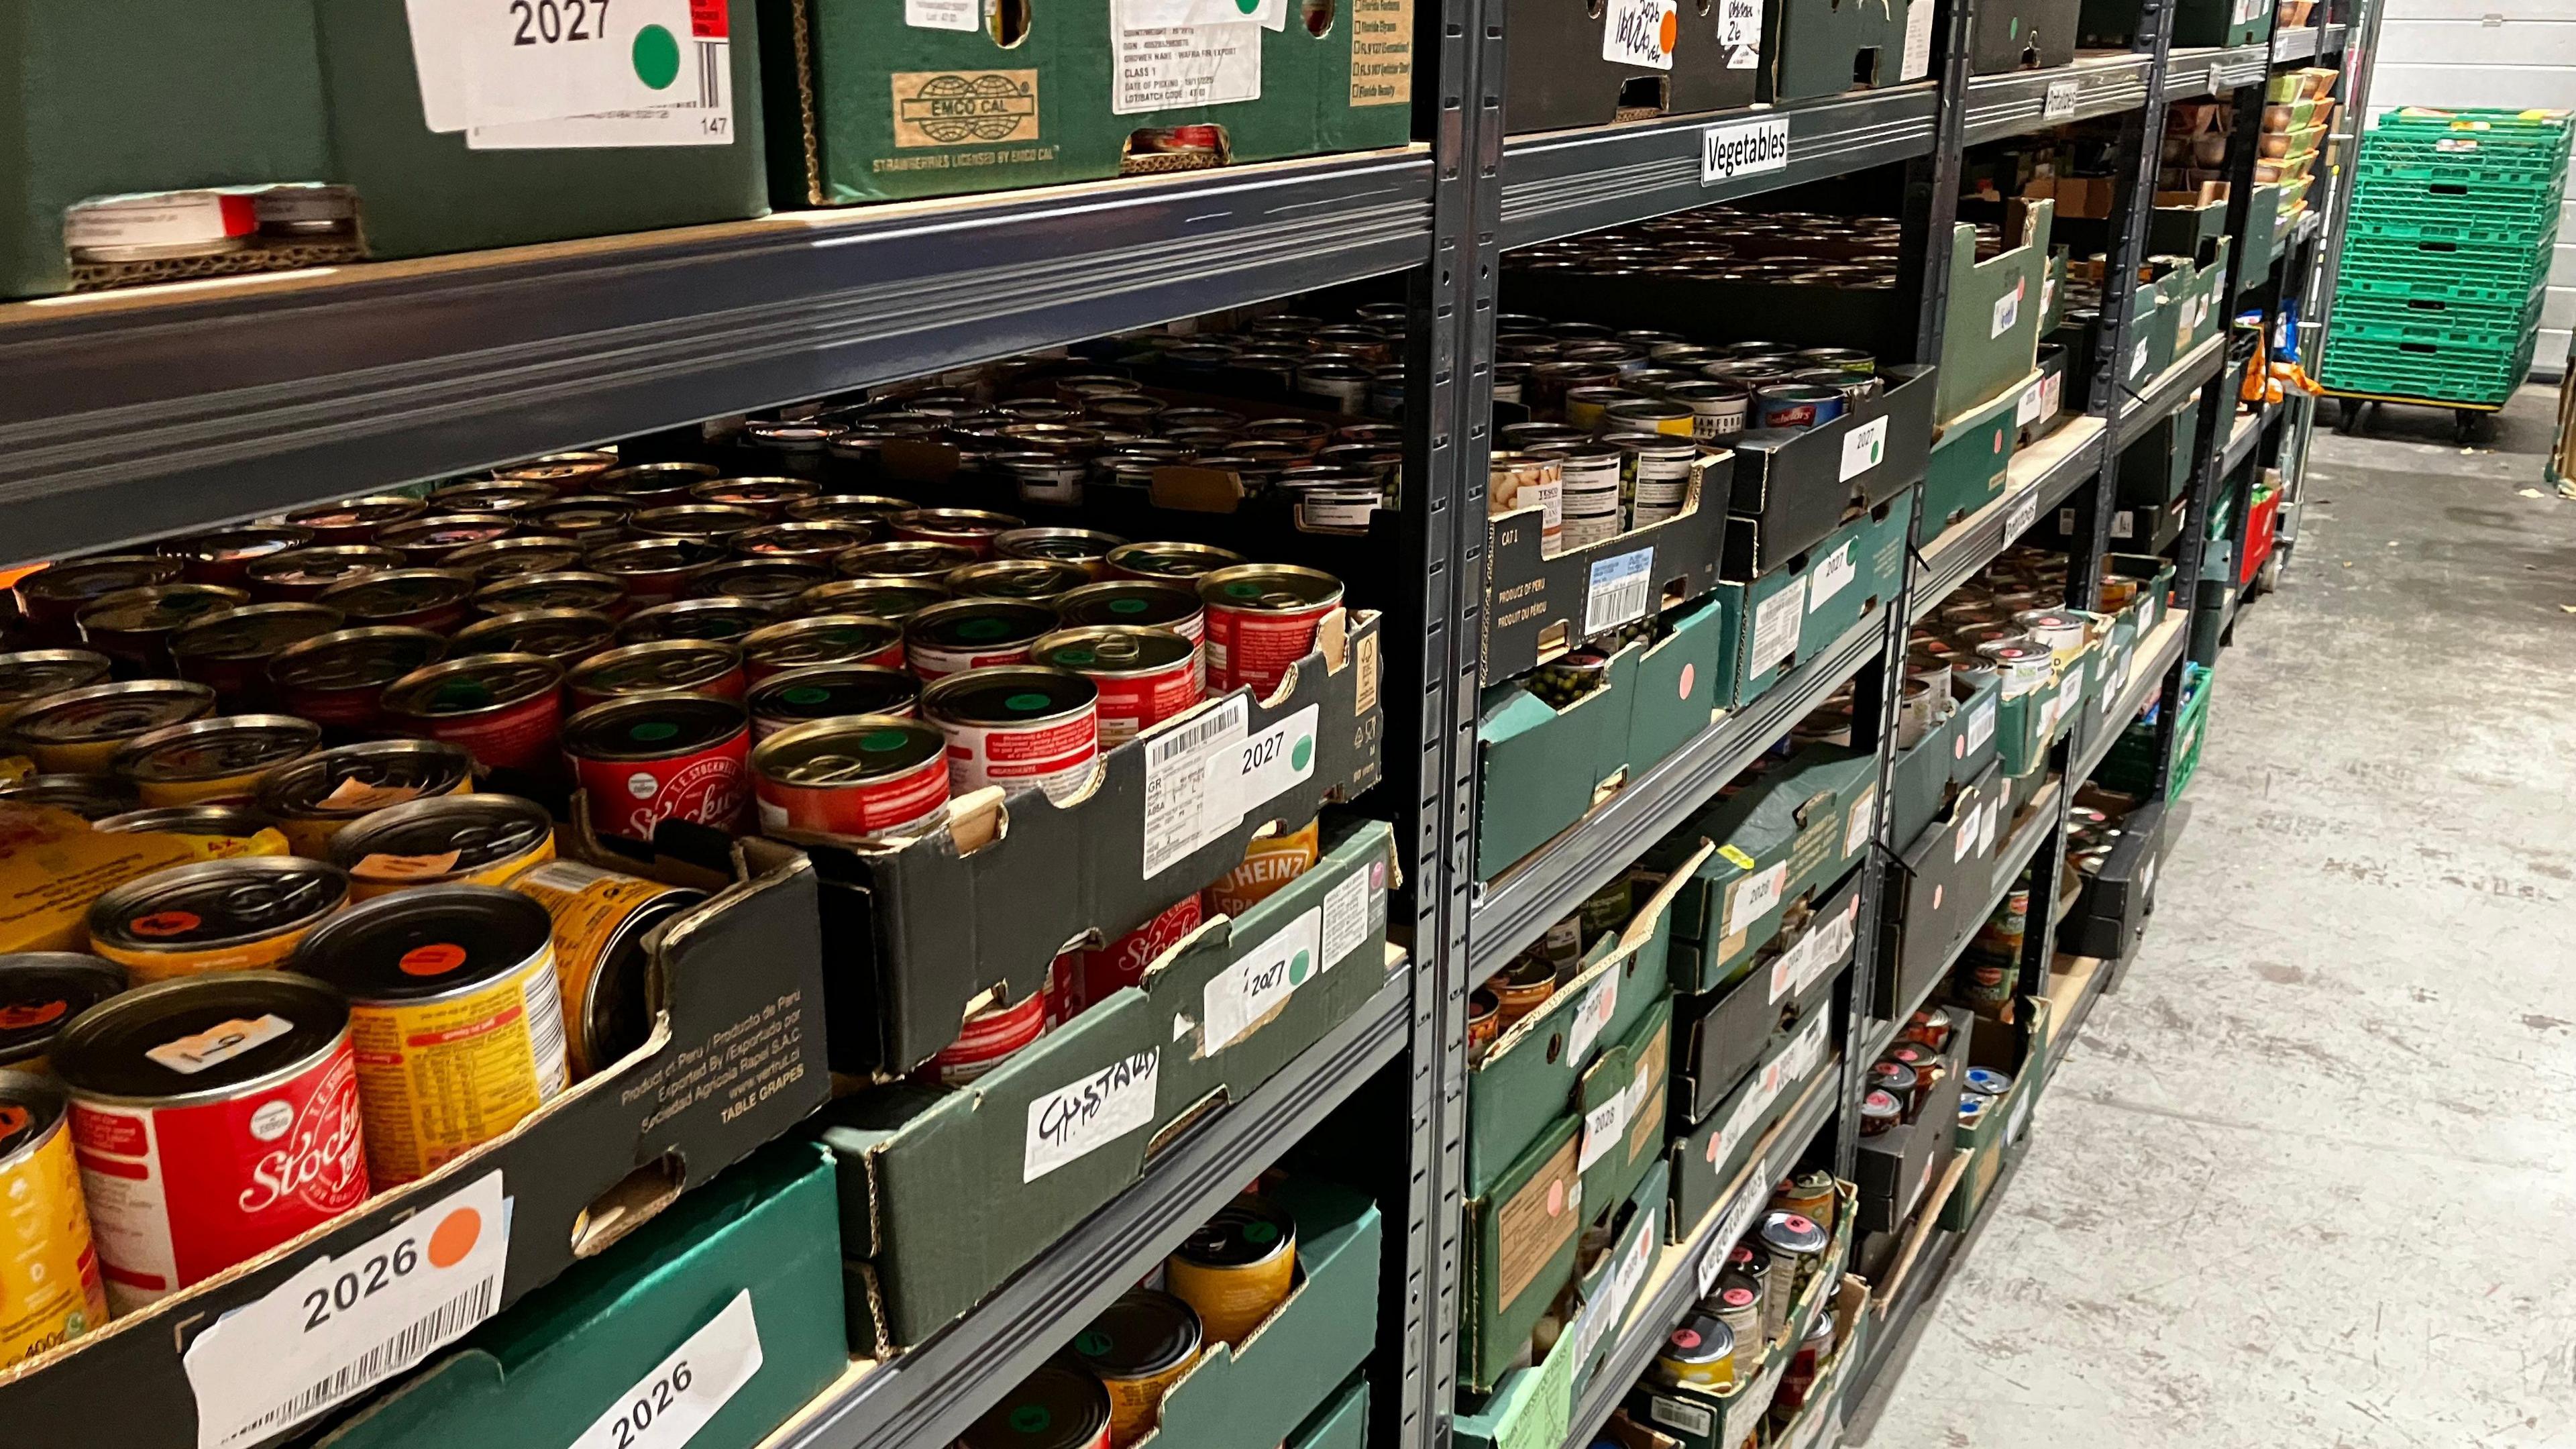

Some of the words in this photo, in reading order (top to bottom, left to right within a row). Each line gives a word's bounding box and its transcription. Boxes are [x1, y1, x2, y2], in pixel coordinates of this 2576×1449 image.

[509, 0, 608, 46] 2027
[1125, 68, 1149, 78] CLASS
[701, 118, 727, 134] 147
[932, 101, 975, 116] EMCO
[981, 99, 1008, 113] CAL
[1709, 125, 1785, 176] Vegetables
[1857, 427, 1875, 449] 2027
[1501, 529, 1514, 547] CAT
[1499, 584, 1523, 604] PRODUCE
[1523, 582, 1532, 596] OF
[1532, 577, 1546, 593] PERU
[1498, 609, 1521, 629] PRODUIT
[1242, 731, 1284, 775] 2027
[1148, 777, 1162, 792] GR
[1234, 856, 1304, 888] HEINZ
[621, 1070, 662, 1106] Product
[678, 1046, 704, 1069] Peru
[713, 1012, 761, 1047] Producto
[778, 989, 801, 1010] Peru
[658, 1062, 707, 1103] Exported
[709, 1055, 724, 1072] By
[784, 1008, 801, 1029] por
[721, 1092, 757, 1124] TABLE
[759, 1063, 804, 1101] GRAPES
[1701, 1173, 1764, 1281] Vegetables
[303, 1237, 418, 1334] 2026
[612, 1360, 692, 1449] 2026
